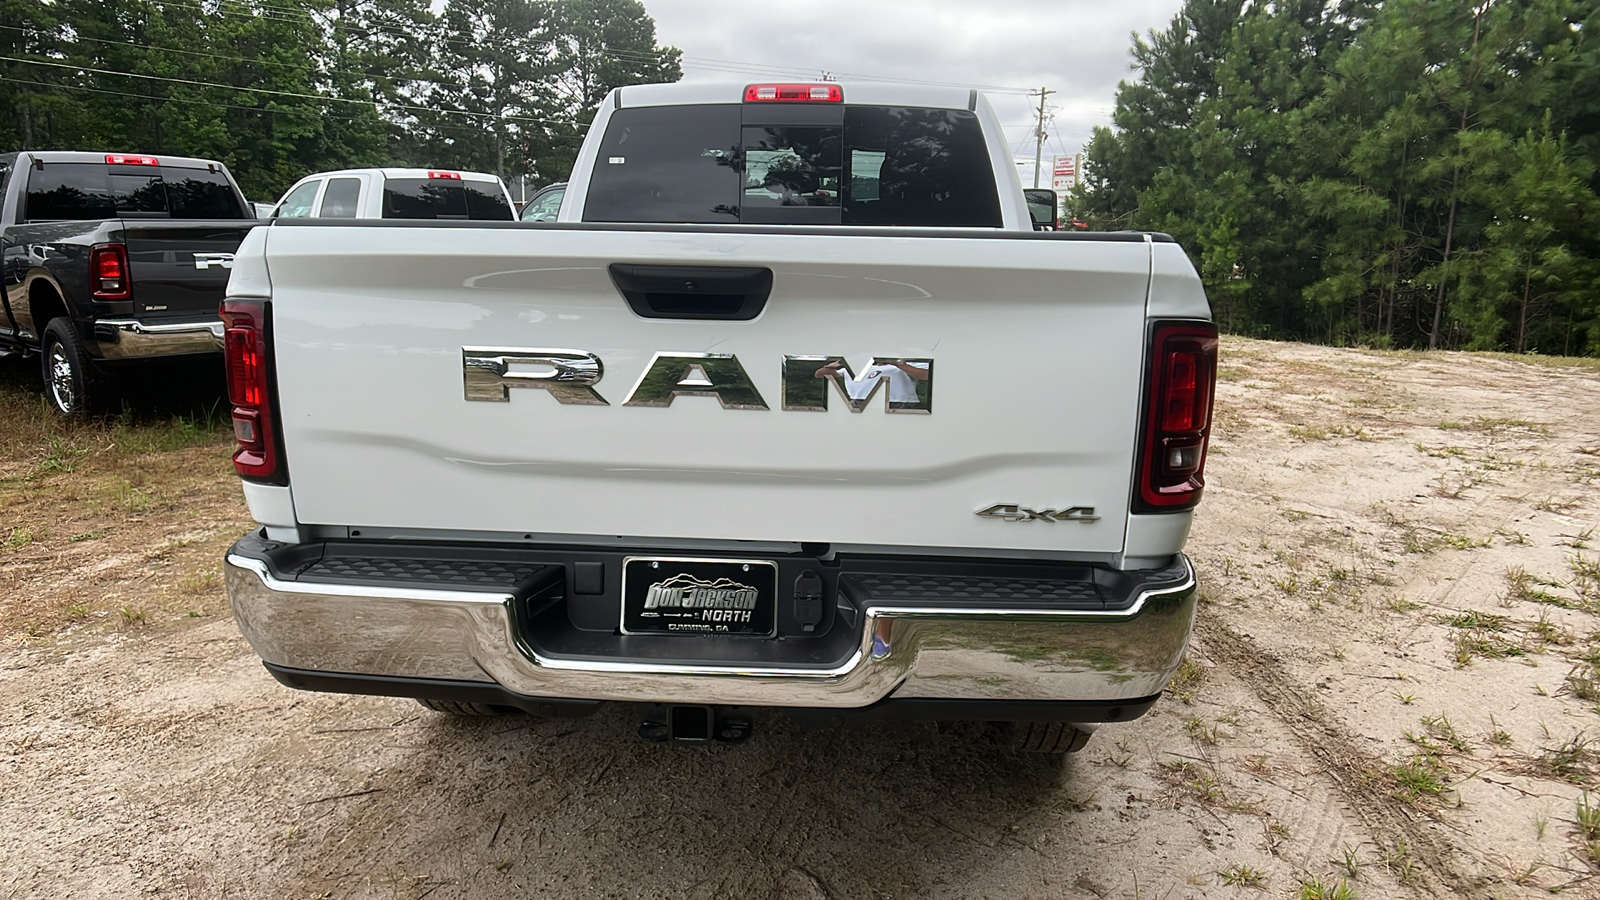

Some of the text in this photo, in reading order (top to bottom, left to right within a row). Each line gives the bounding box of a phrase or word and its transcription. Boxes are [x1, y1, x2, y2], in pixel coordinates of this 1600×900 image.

[461, 345, 935, 414] RAM
[644, 587, 759, 610] DON JACKSON
[702, 609, 751, 622] NORTH
[715, 624, 729, 632] GA
